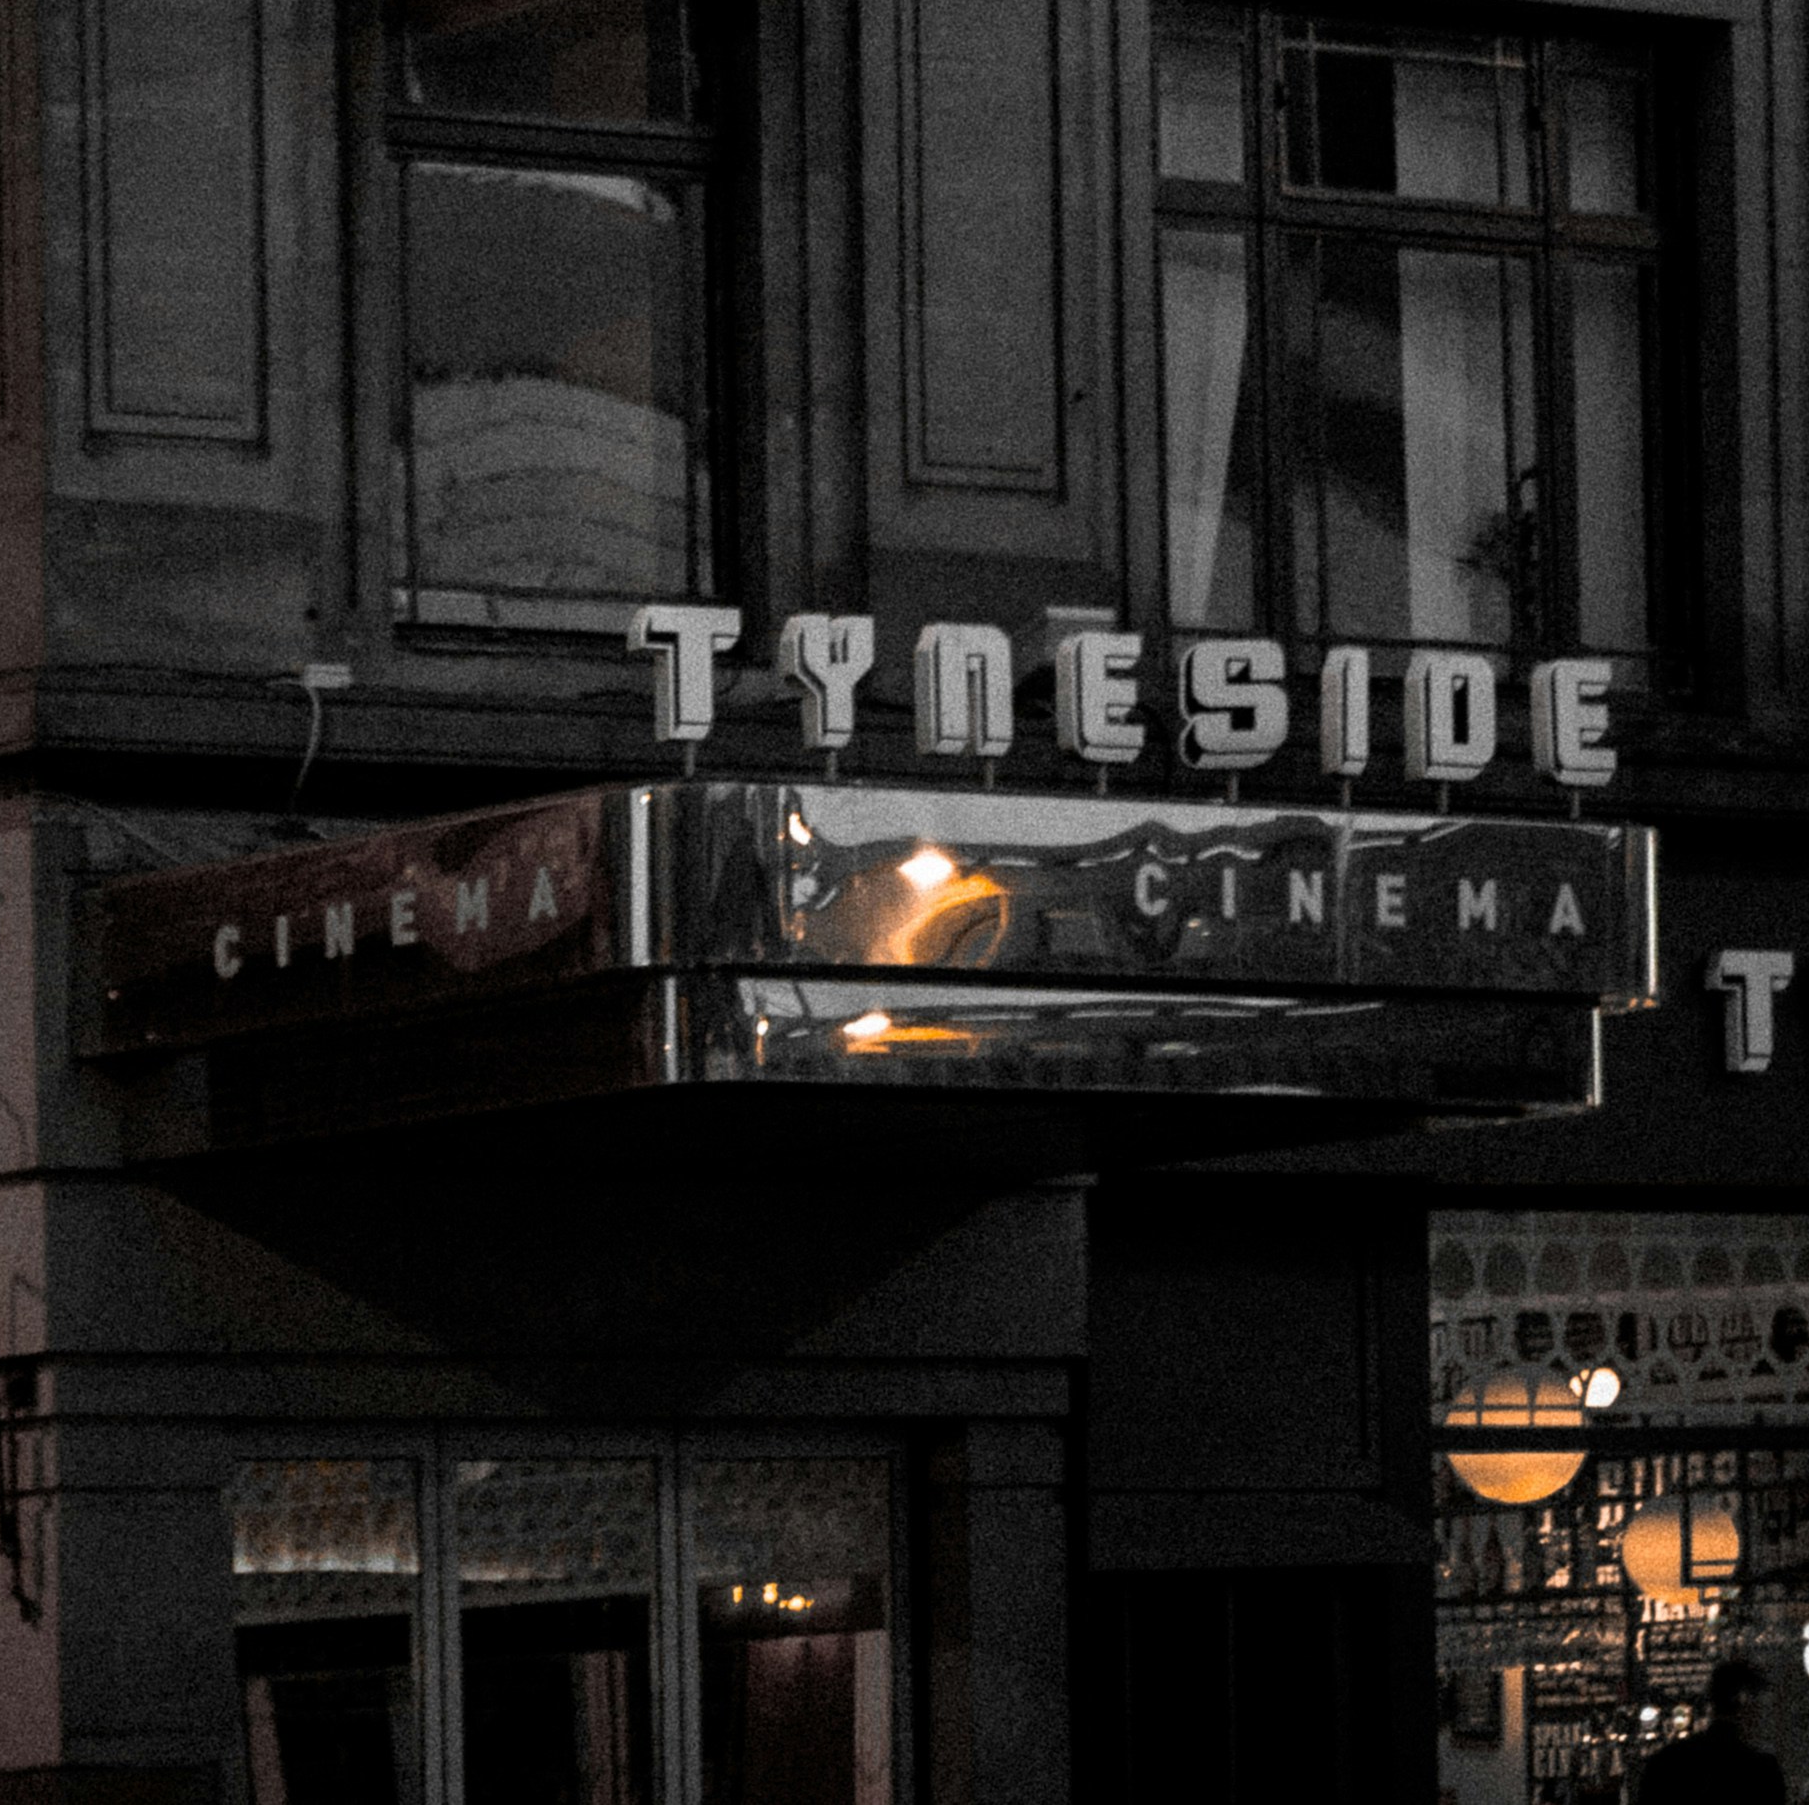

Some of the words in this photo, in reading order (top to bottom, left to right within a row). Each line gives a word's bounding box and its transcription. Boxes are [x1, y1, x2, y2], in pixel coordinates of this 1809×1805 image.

[627, 605, 1619, 787] TYNESIDE
[212, 866, 559, 979] CINEMA
[1134, 863, 1585, 937] CINEMA
